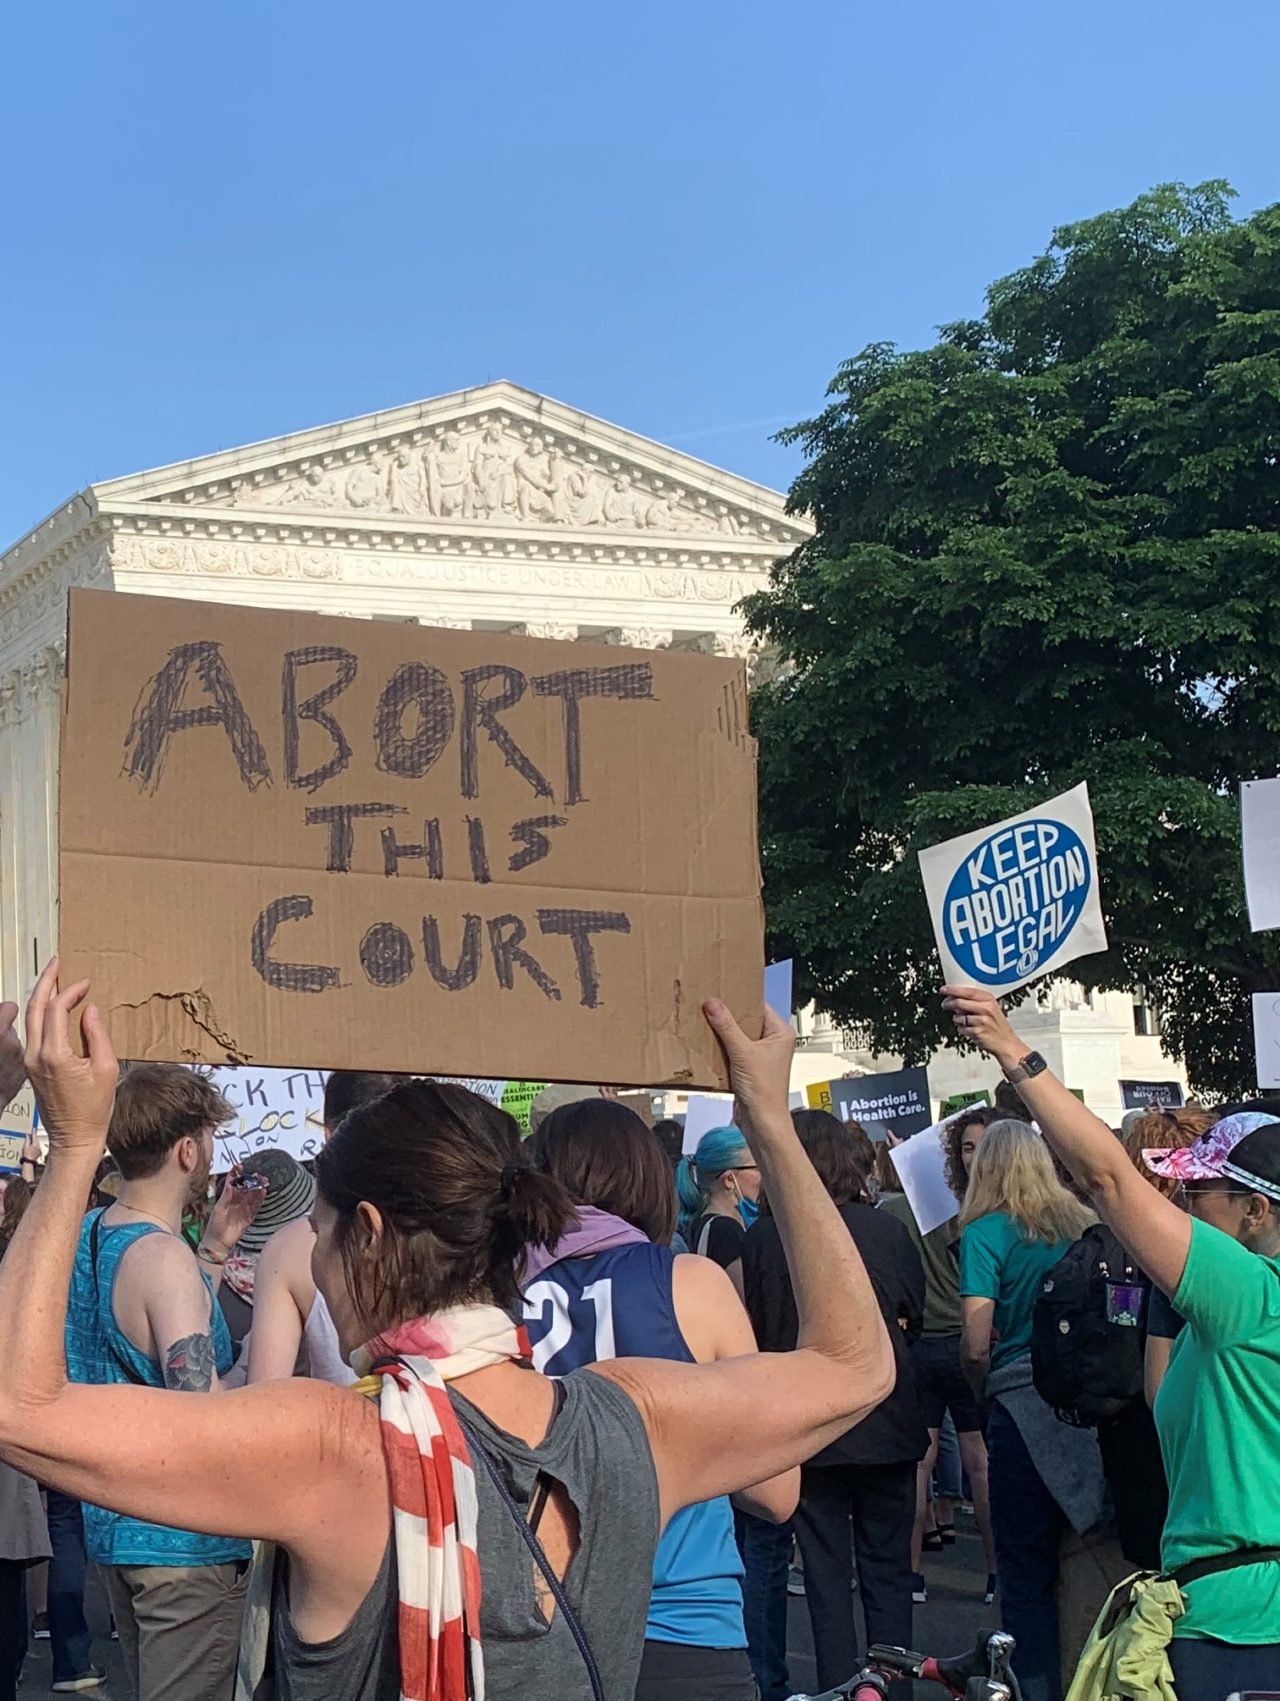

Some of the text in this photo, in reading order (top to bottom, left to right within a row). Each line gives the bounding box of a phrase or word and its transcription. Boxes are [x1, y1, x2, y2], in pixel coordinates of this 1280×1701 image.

[518, 568, 581, 588] UNDER
[594, 574, 630, 589] LAW
[121, 640, 659, 805] ABORT
[305, 802, 569, 882] THIS
[967, 824, 1059, 890] KEEP
[950, 845, 1086, 946] ABORTION
[251, 895, 631, 1009] COURT
[972, 899, 1075, 975] LEGAL
[850, 1090, 918, 1111] Abortion is
[852, 1106, 897, 1123] Health
[897, 1101, 926, 1117] Care.
[522, 1278, 616, 1380] 21
